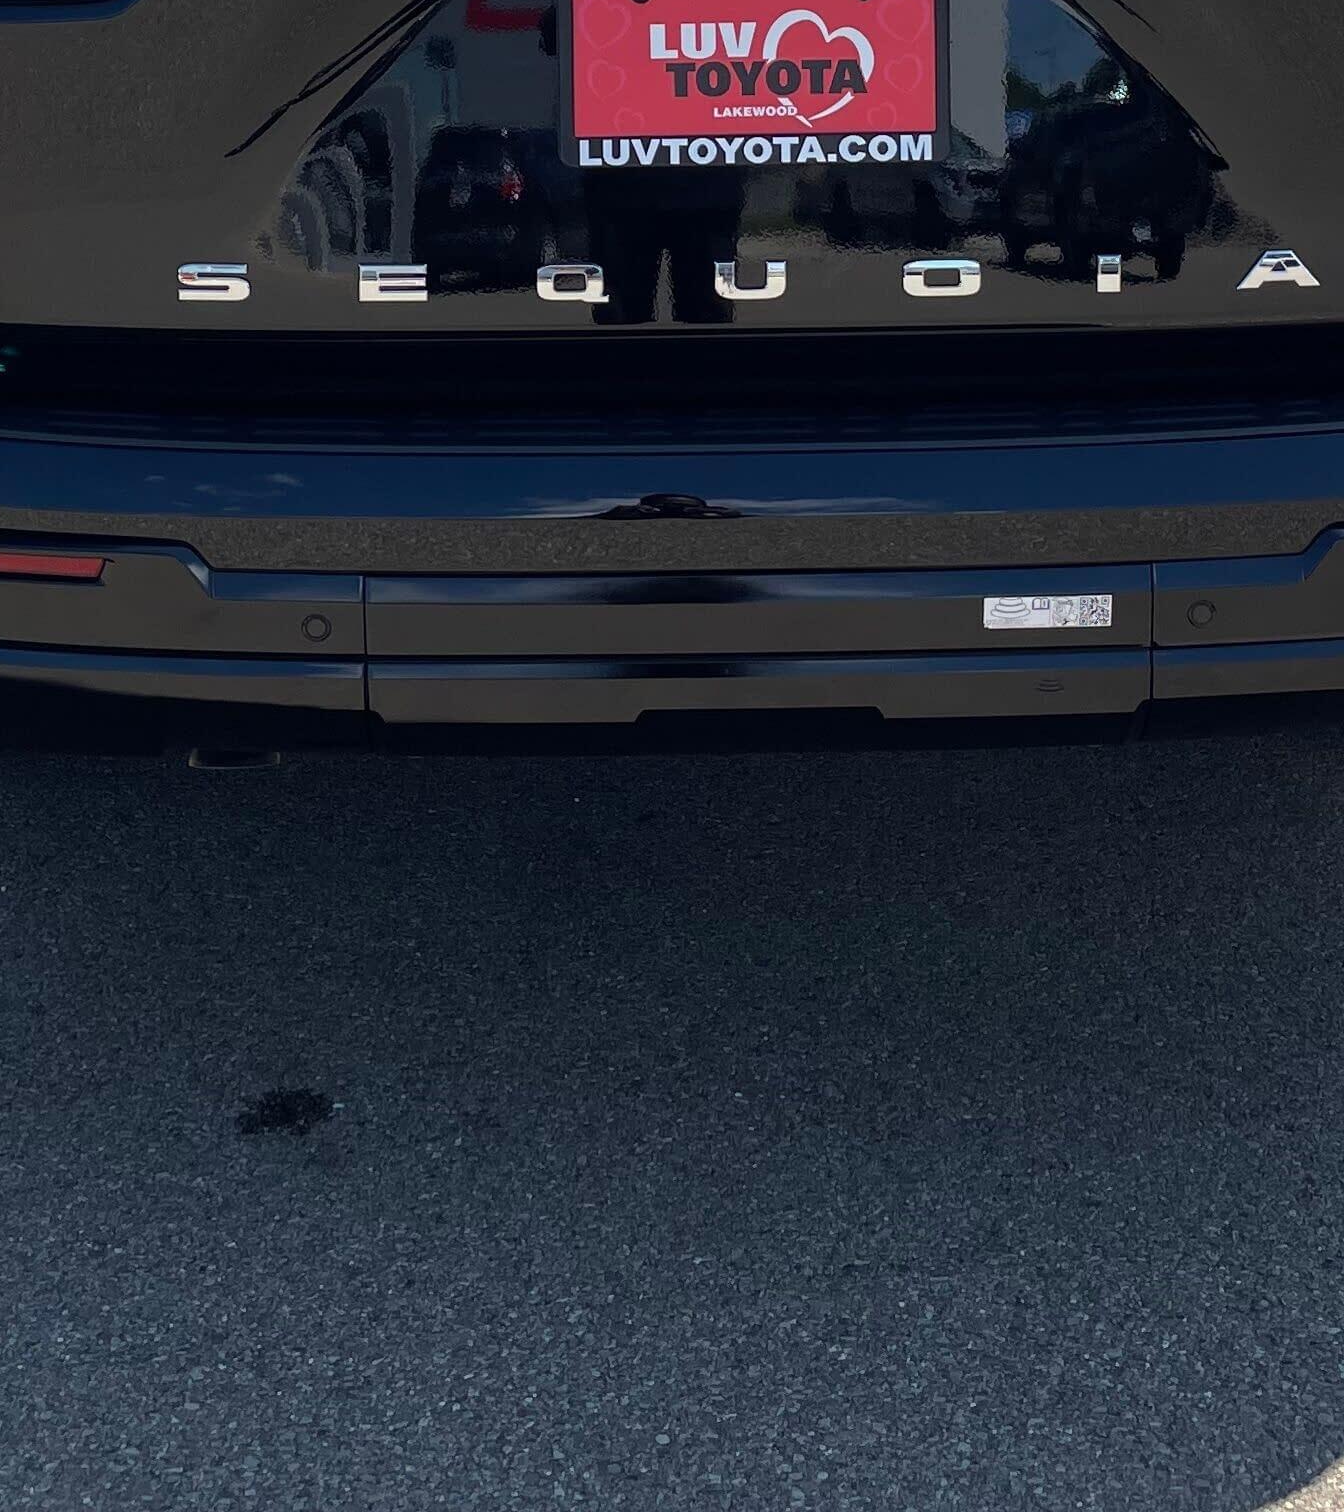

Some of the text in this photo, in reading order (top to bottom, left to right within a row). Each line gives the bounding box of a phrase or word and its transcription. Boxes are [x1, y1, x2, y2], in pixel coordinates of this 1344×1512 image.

[649, 22, 757, 60] LUV
[666, 60, 868, 98] TOYOTA
[713, 105, 799, 119] LAKEWOOD
[579, 134, 934, 167] LUVTOYOTA.COM
[177, 249, 1321, 303] SEQUOIA
